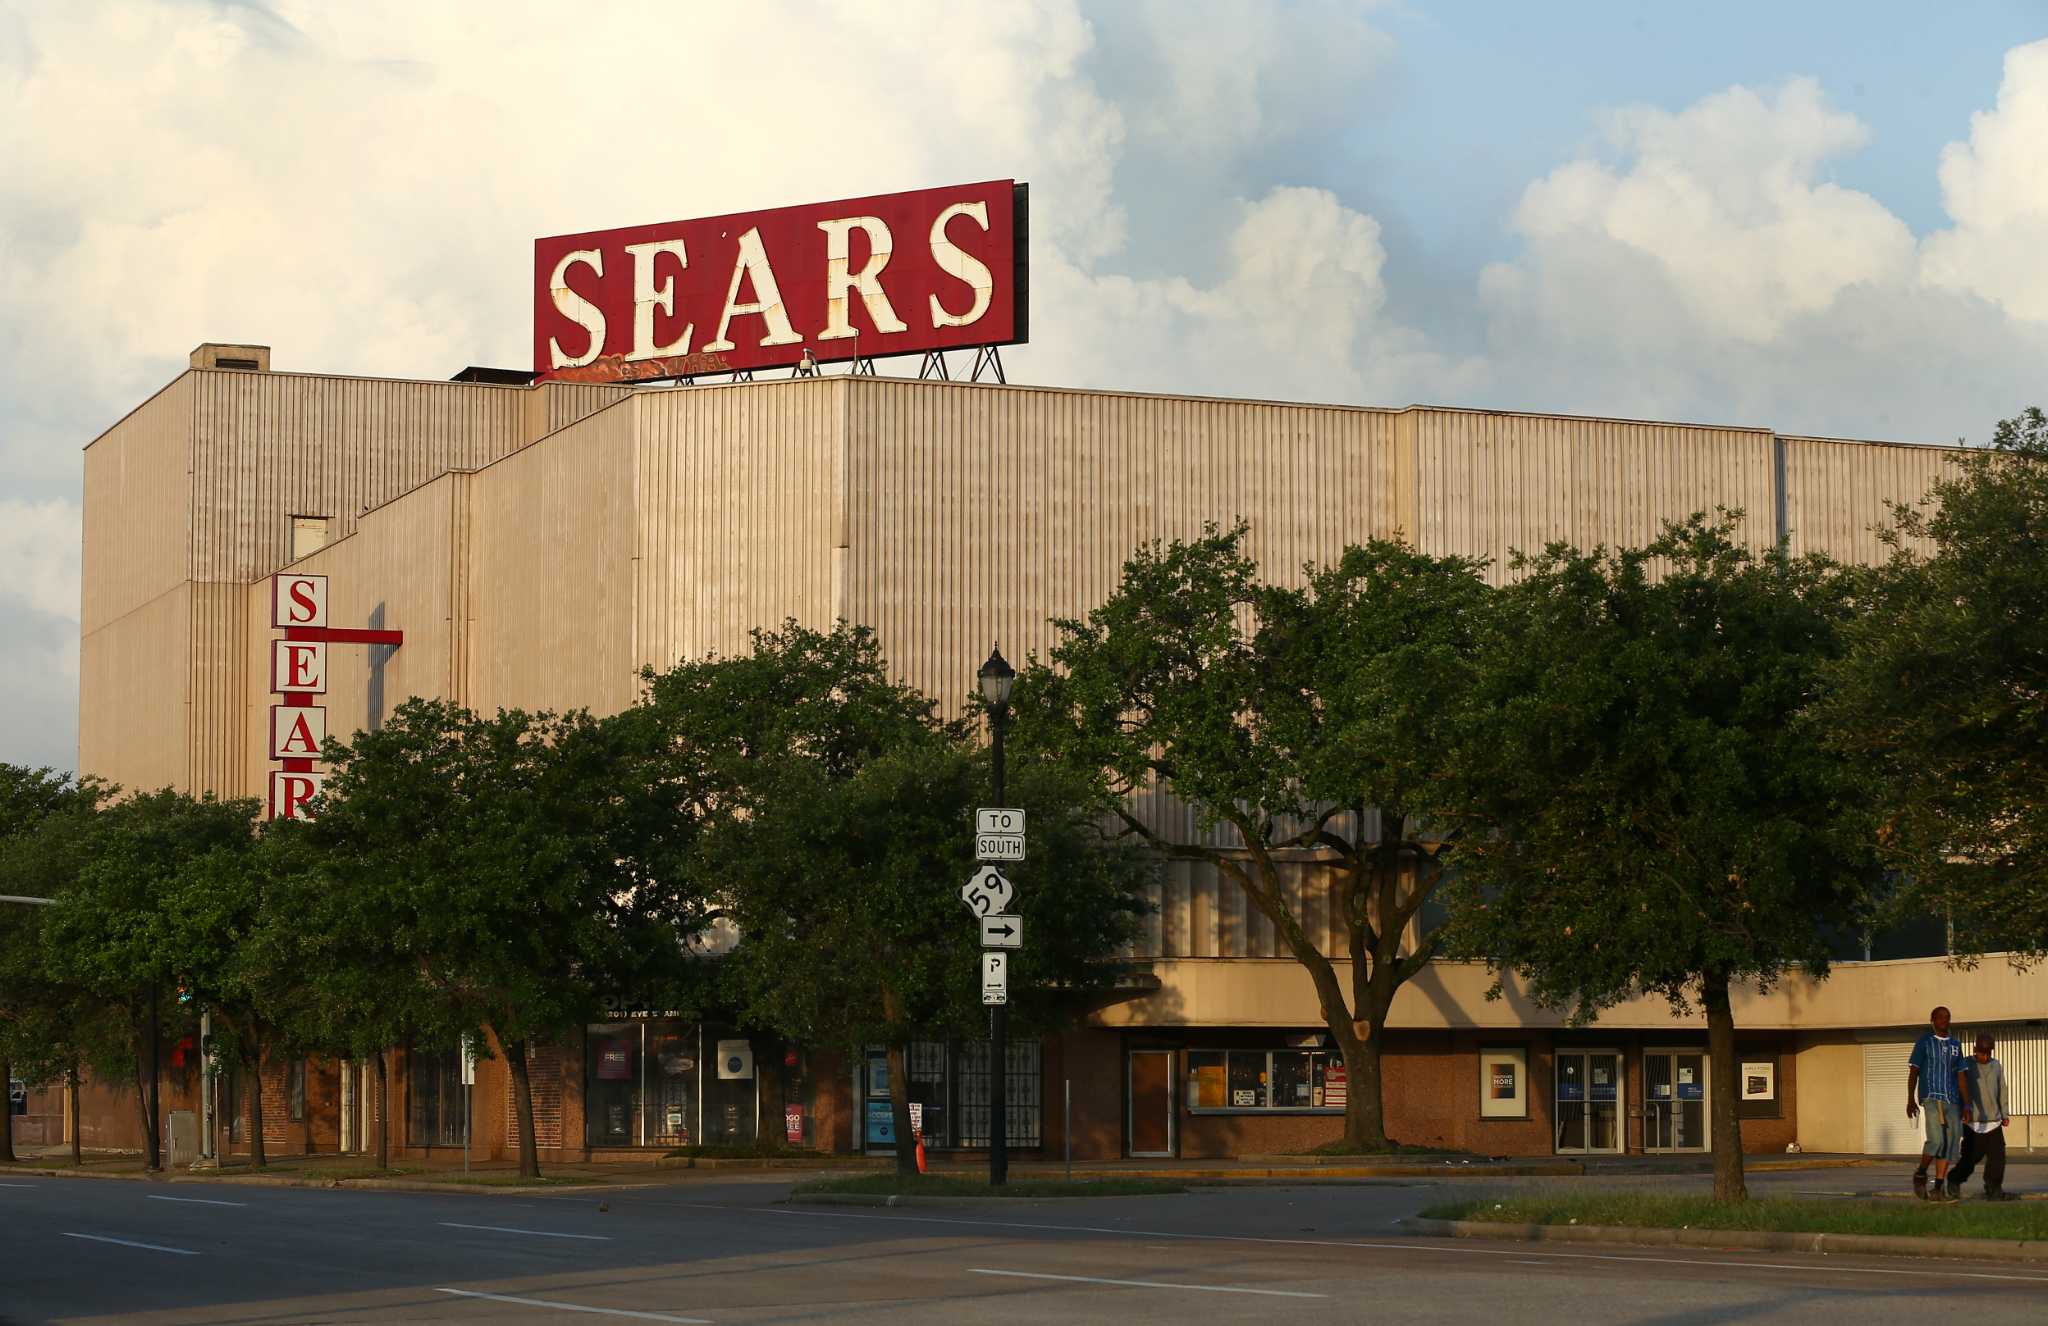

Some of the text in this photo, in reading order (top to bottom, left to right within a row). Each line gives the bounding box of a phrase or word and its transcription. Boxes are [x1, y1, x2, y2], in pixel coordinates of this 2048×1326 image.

[549, 200, 993, 370] SEARS
[989, 814, 1011, 828] TO
[980, 840, 1020, 854] SOUTH
[968, 873, 1003, 914] 59
